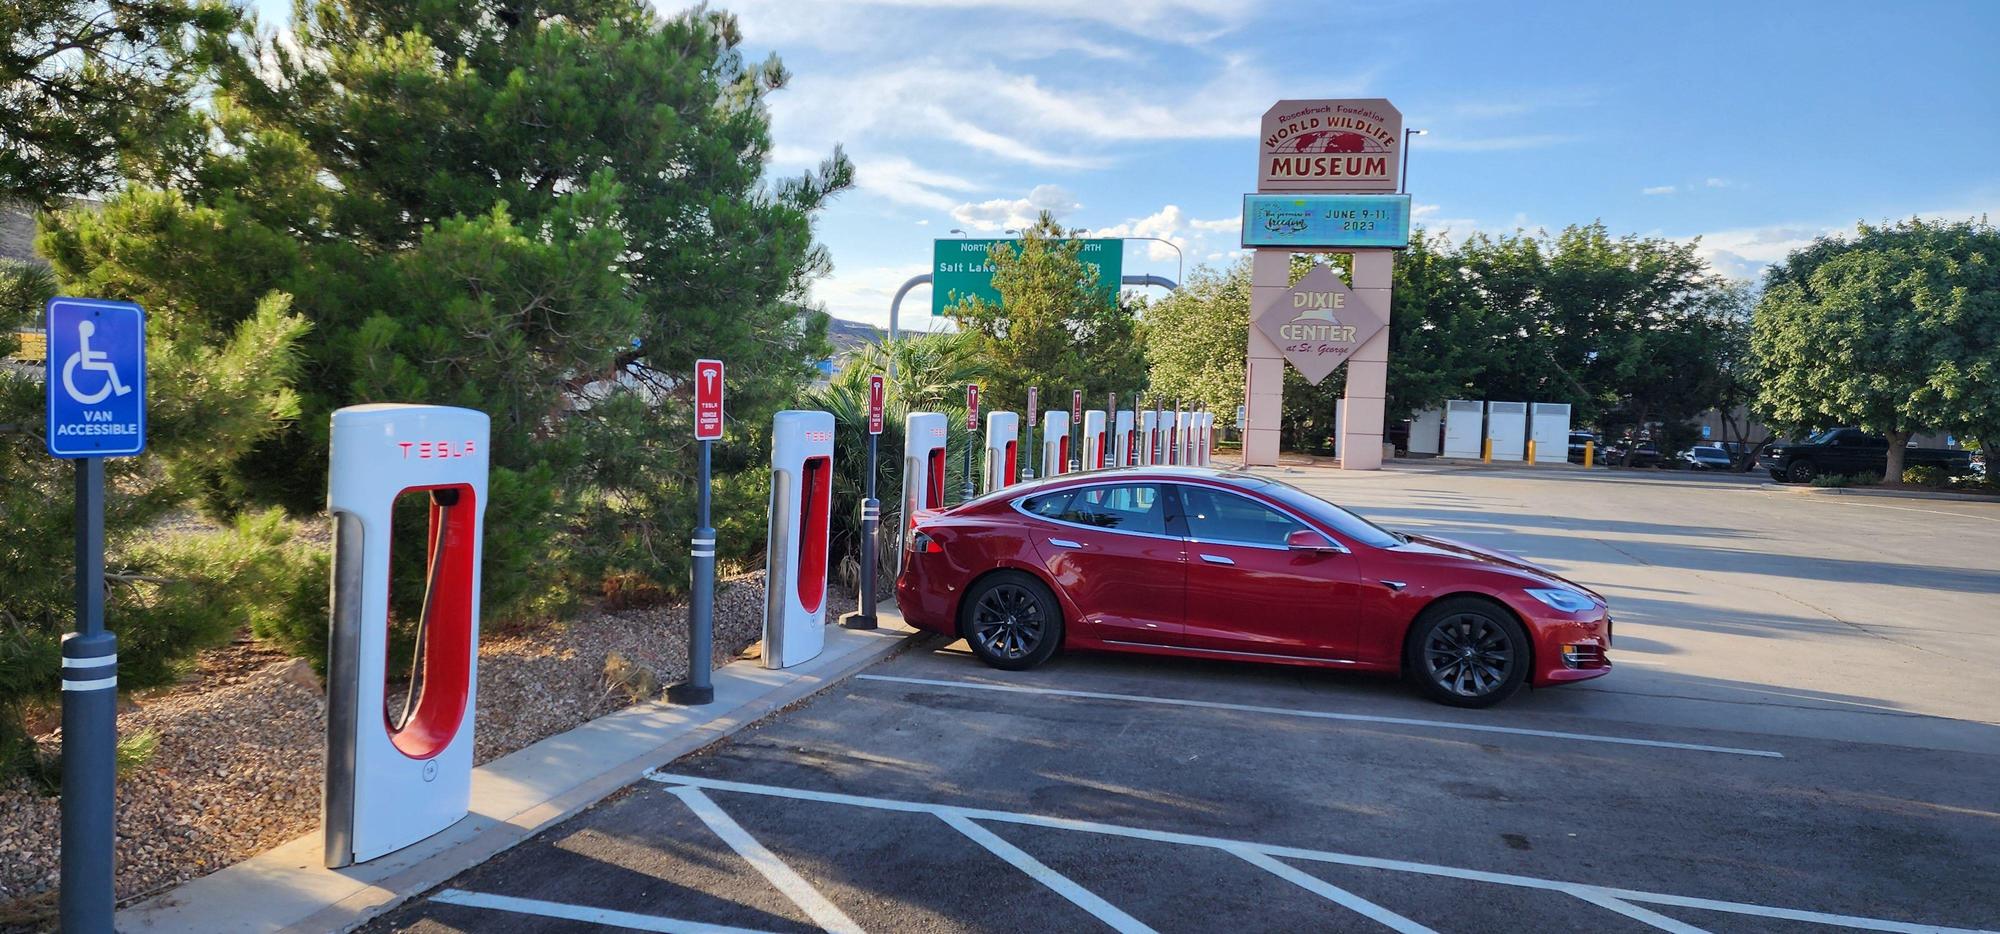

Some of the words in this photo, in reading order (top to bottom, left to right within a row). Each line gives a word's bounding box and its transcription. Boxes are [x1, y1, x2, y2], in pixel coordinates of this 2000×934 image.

[1278, 105, 1332, 124] Rosenbruch
[1336, 105, 1385, 123] Foundation
[1265, 118, 1321, 149] WORLD
[1327, 116, 1395, 148] WILDLIFE
[1271, 157, 1386, 176] MUSEUM
[1325, 210, 1356, 219] JUNE
[1343, 221, 1375, 231] 2023
[960, 242, 989, 252] NORTH
[940, 262, 964, 272] Salt
[1294, 292, 1344, 308] DIXIE
[1279, 324, 1358, 343] CENTER
[1298, 343, 1313, 353] St.
[1318, 344, 1349, 356] George
[83, 411, 113, 422] VAN
[57, 424, 138, 436] ACCESSIBLE
[805, 431, 833, 442] TESLA
[398, 440, 475, 459] TESLA
